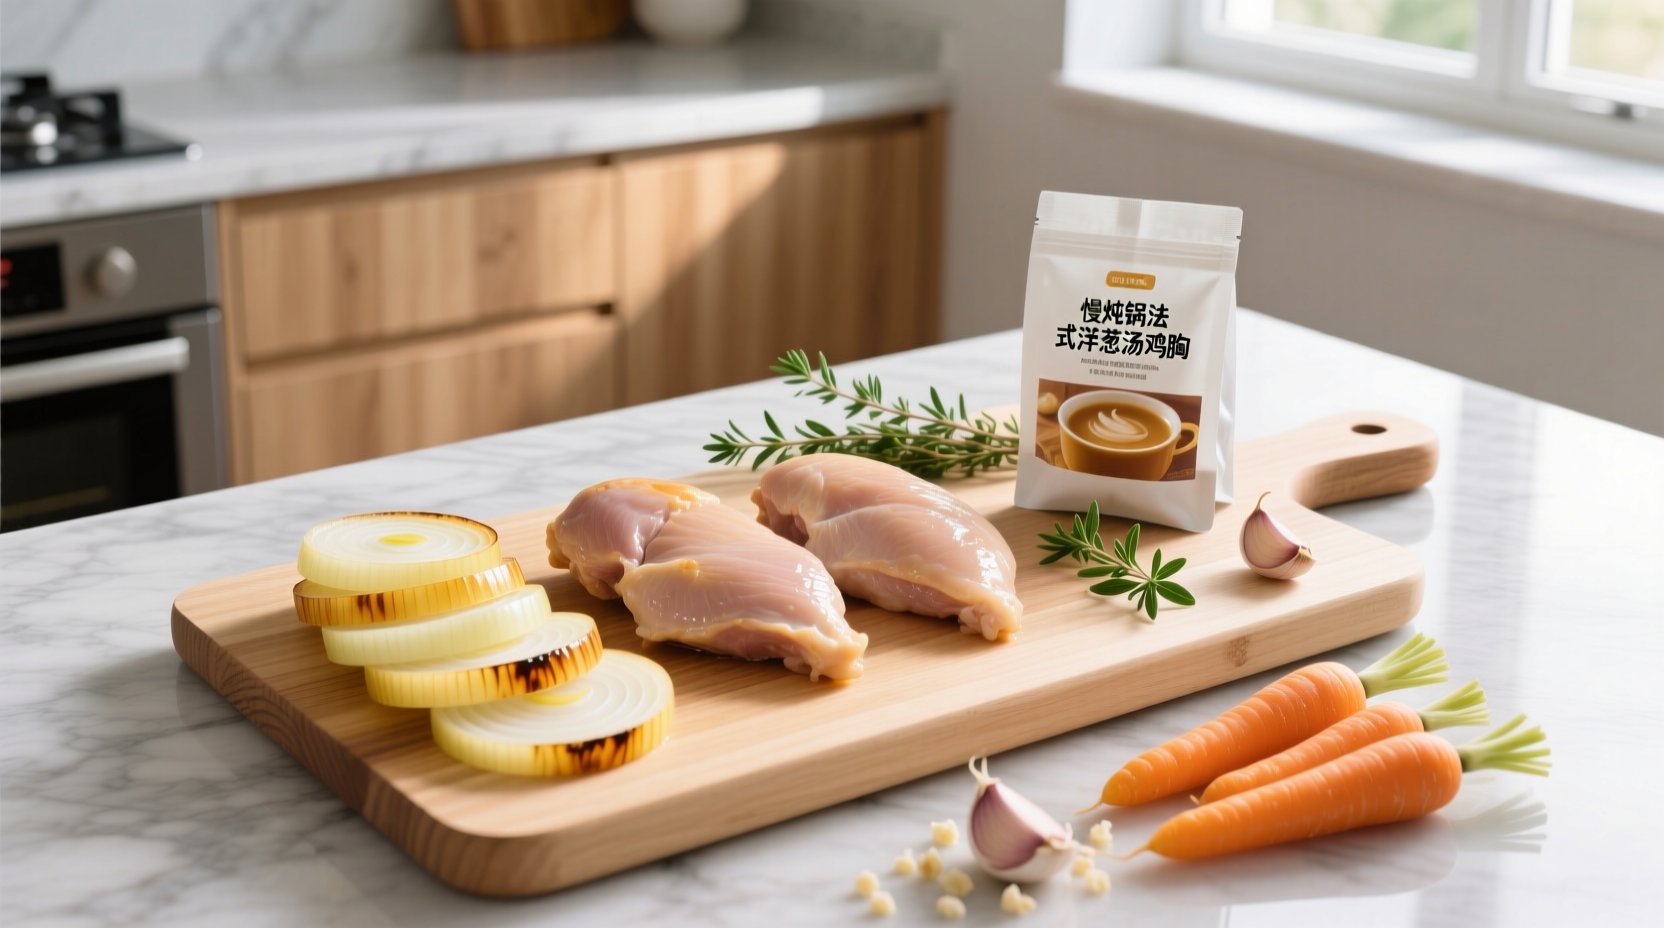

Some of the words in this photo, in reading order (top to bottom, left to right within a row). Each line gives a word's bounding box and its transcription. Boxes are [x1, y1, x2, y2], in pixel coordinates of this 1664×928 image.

[1080, 297, 1170, 328] 慢炖锅法
[1055, 323, 1191, 360] 式洋葱汤鸡胸
